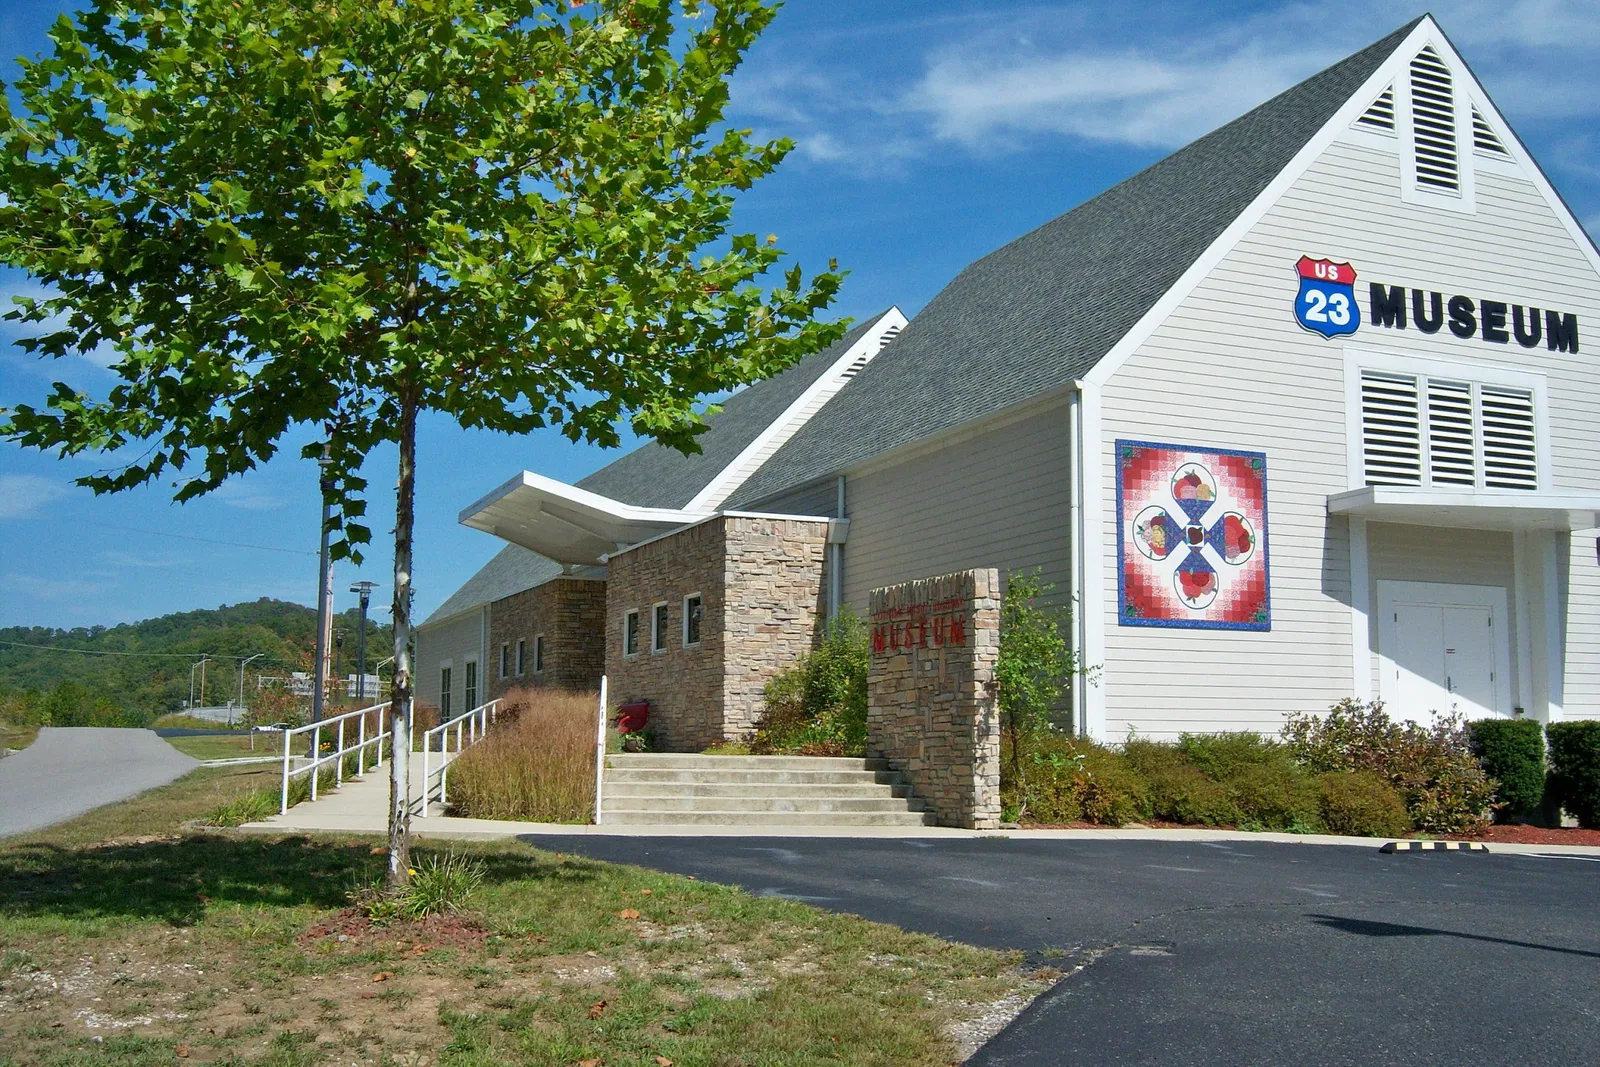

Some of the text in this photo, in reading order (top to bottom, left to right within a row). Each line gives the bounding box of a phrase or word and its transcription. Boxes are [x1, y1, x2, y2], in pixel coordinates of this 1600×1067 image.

[1314, 263, 1339, 280] US
[1305, 288, 1350, 326] 23
[1369, 282, 1580, 354] MUSEUM
[872, 614, 967, 654] MUSEUM
